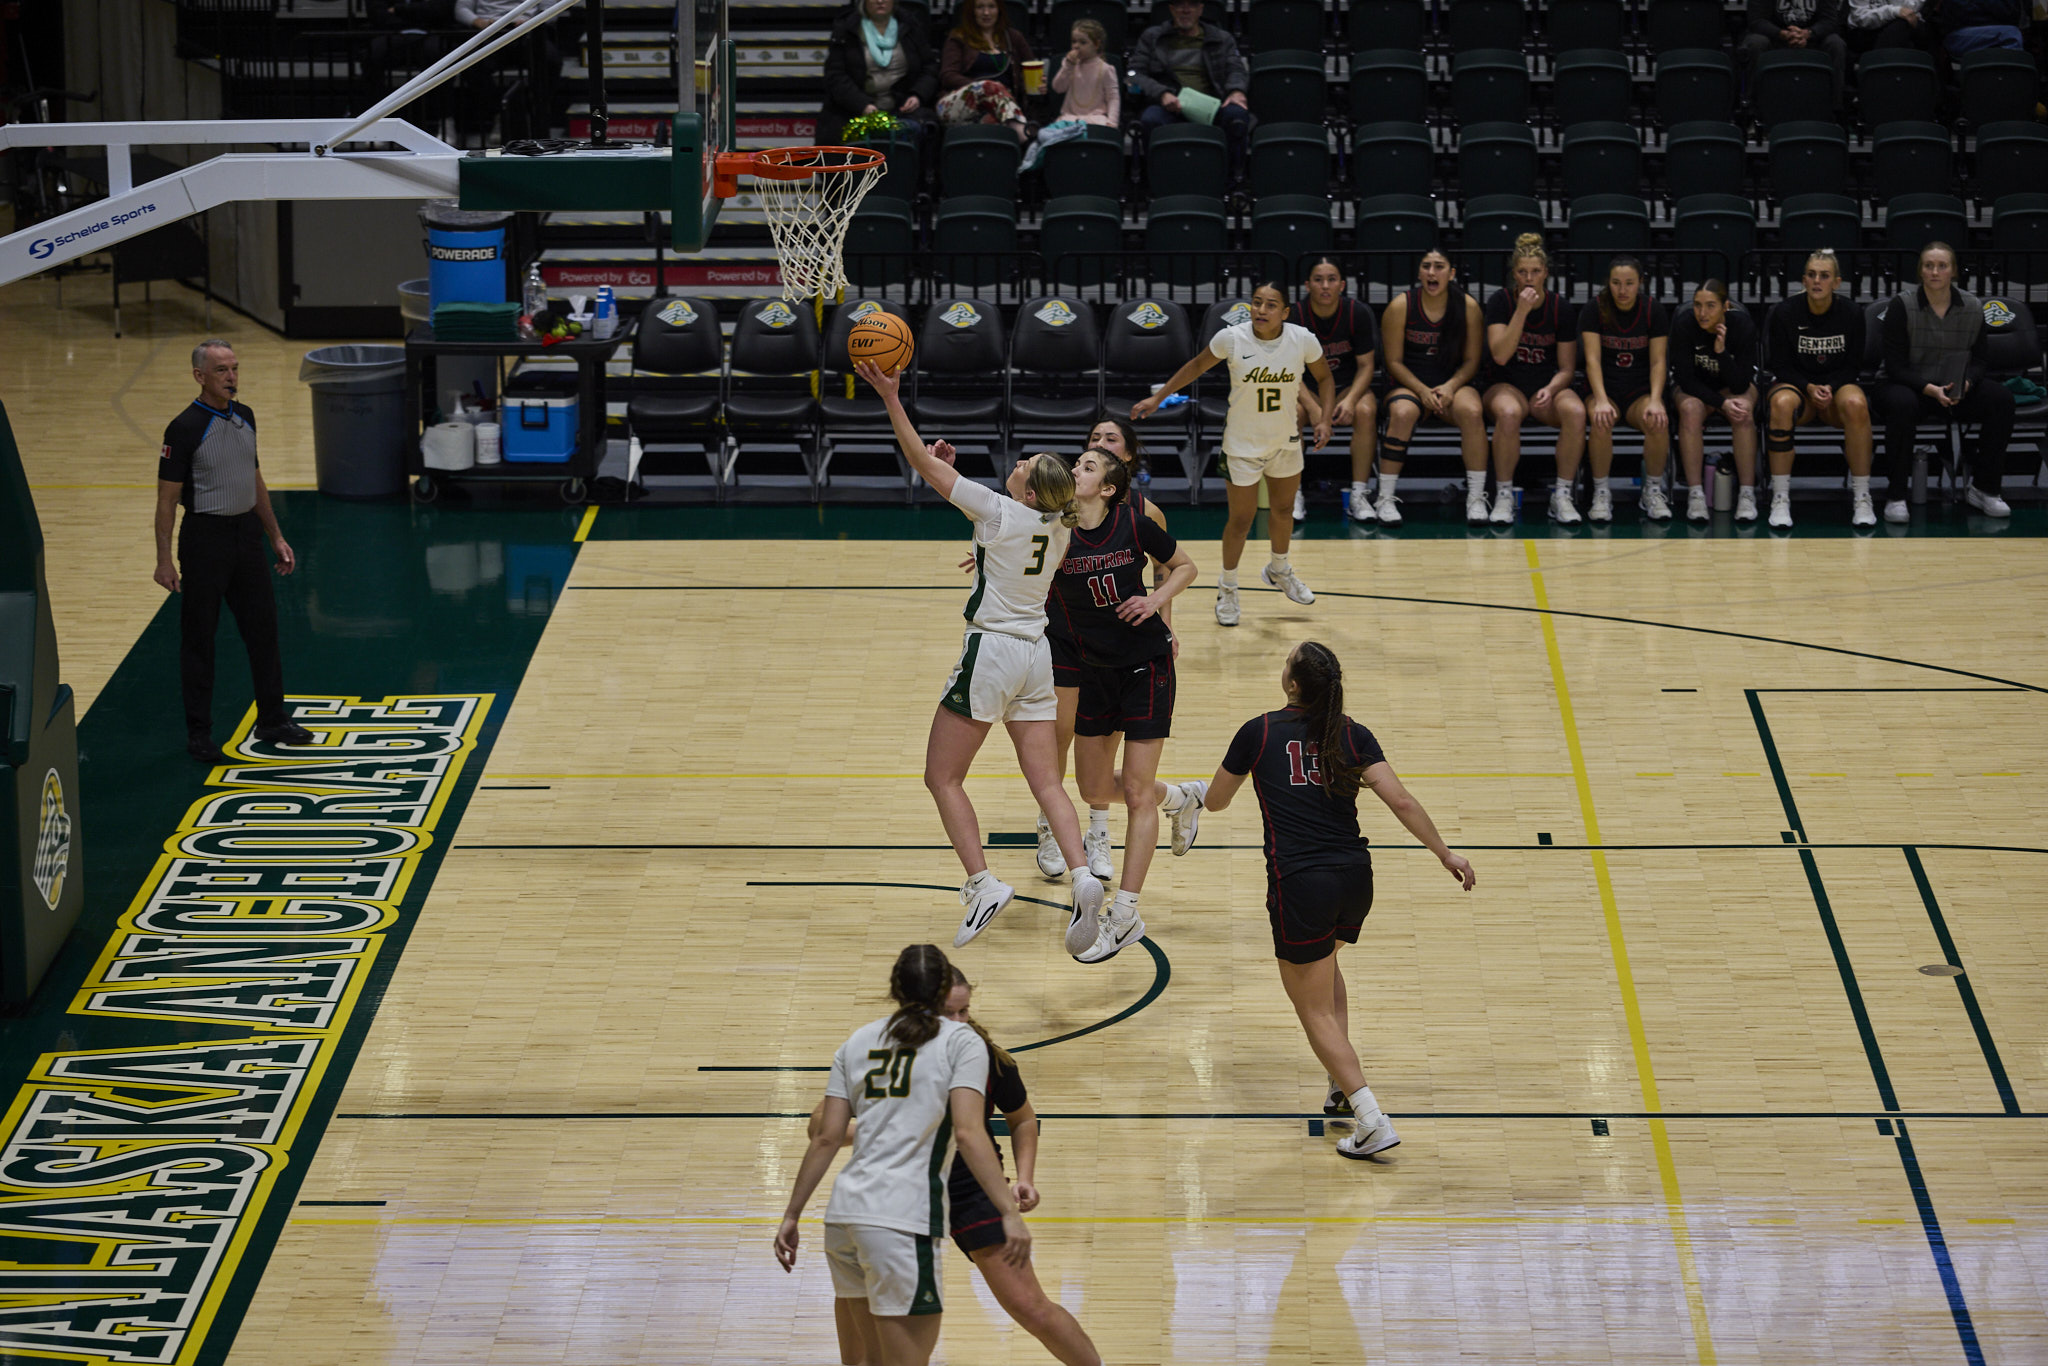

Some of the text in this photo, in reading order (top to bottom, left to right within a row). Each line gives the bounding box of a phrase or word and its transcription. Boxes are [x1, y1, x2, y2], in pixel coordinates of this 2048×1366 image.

[110, 203, 157, 225] Sports
[431, 246, 495, 261] POWERADE
[560, 271, 608, 283] Powered
[610, 271, 623, 284] by
[707, 270, 755, 282] Powered
[757, 271, 771, 283] by
[851, 338, 874, 349] EVO
[1799, 335, 1845, 349] CENTRAL
[1242, 366, 1295, 384] Alaska
[1257, 388, 1281, 412] 12
[1024, 534, 1049, 576] 3
[1062, 549, 1136, 575] CENTRAL
[1087, 573, 1122, 608] 11
[1286, 740, 1335, 786] 13
[0, 693, 490, 1366] ALASKA ANCHORAGE
[864, 1047, 917, 1100] 20
